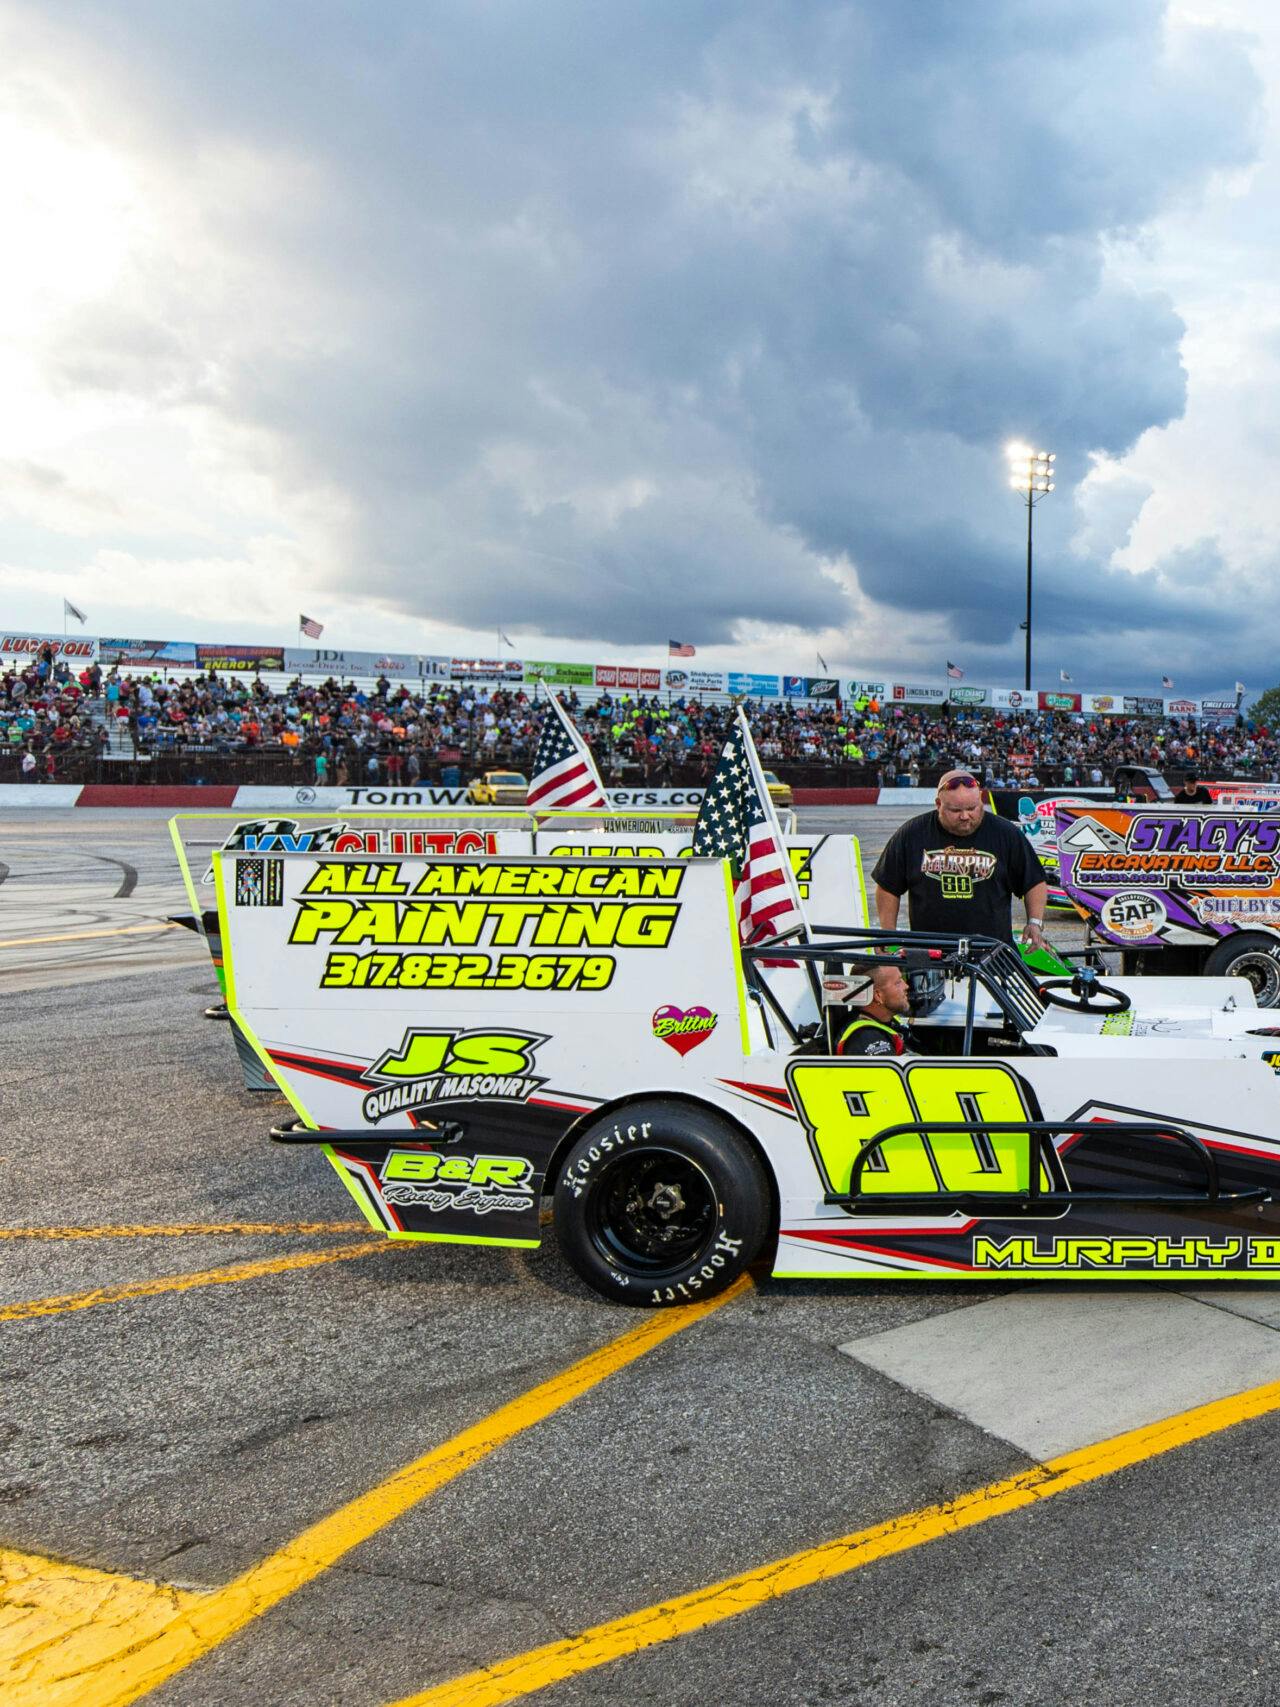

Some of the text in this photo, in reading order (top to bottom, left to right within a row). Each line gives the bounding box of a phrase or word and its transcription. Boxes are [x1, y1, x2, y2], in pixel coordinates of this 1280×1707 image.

[1, 636, 62, 655] LUCAS
[63, 641, 95, 658] OIL
[204, 659, 256, 671] ENERGY
[906, 687, 944, 697] LINCOLN TECH
[603, 819, 637, 833] HAMMER
[301, 861, 687, 899] ALL AMERICAN
[921, 851, 997, 877] MURPHY
[1079, 853, 1223, 874] EXCAVATING
[288, 898, 683, 949] PAINTING
[1109, 902, 1156, 924] SAP
[319, 951, 617, 991] 317.832.3679
[653, 1010, 718, 1038] Brittni
[372, 1029, 545, 1079] JS
[364, 1074, 547, 1122] QUALITY MASONRY
[786, 1060, 1070, 1218] 80
[381, 1152, 533, 1191] B&R
[563, 1118, 652, 1199] Hoosier
[383, 1185, 532, 1213] Racing Engines
[651, 1229, 743, 1304] Hoosier
[972, 1236, 1242, 1269] MURPHY
